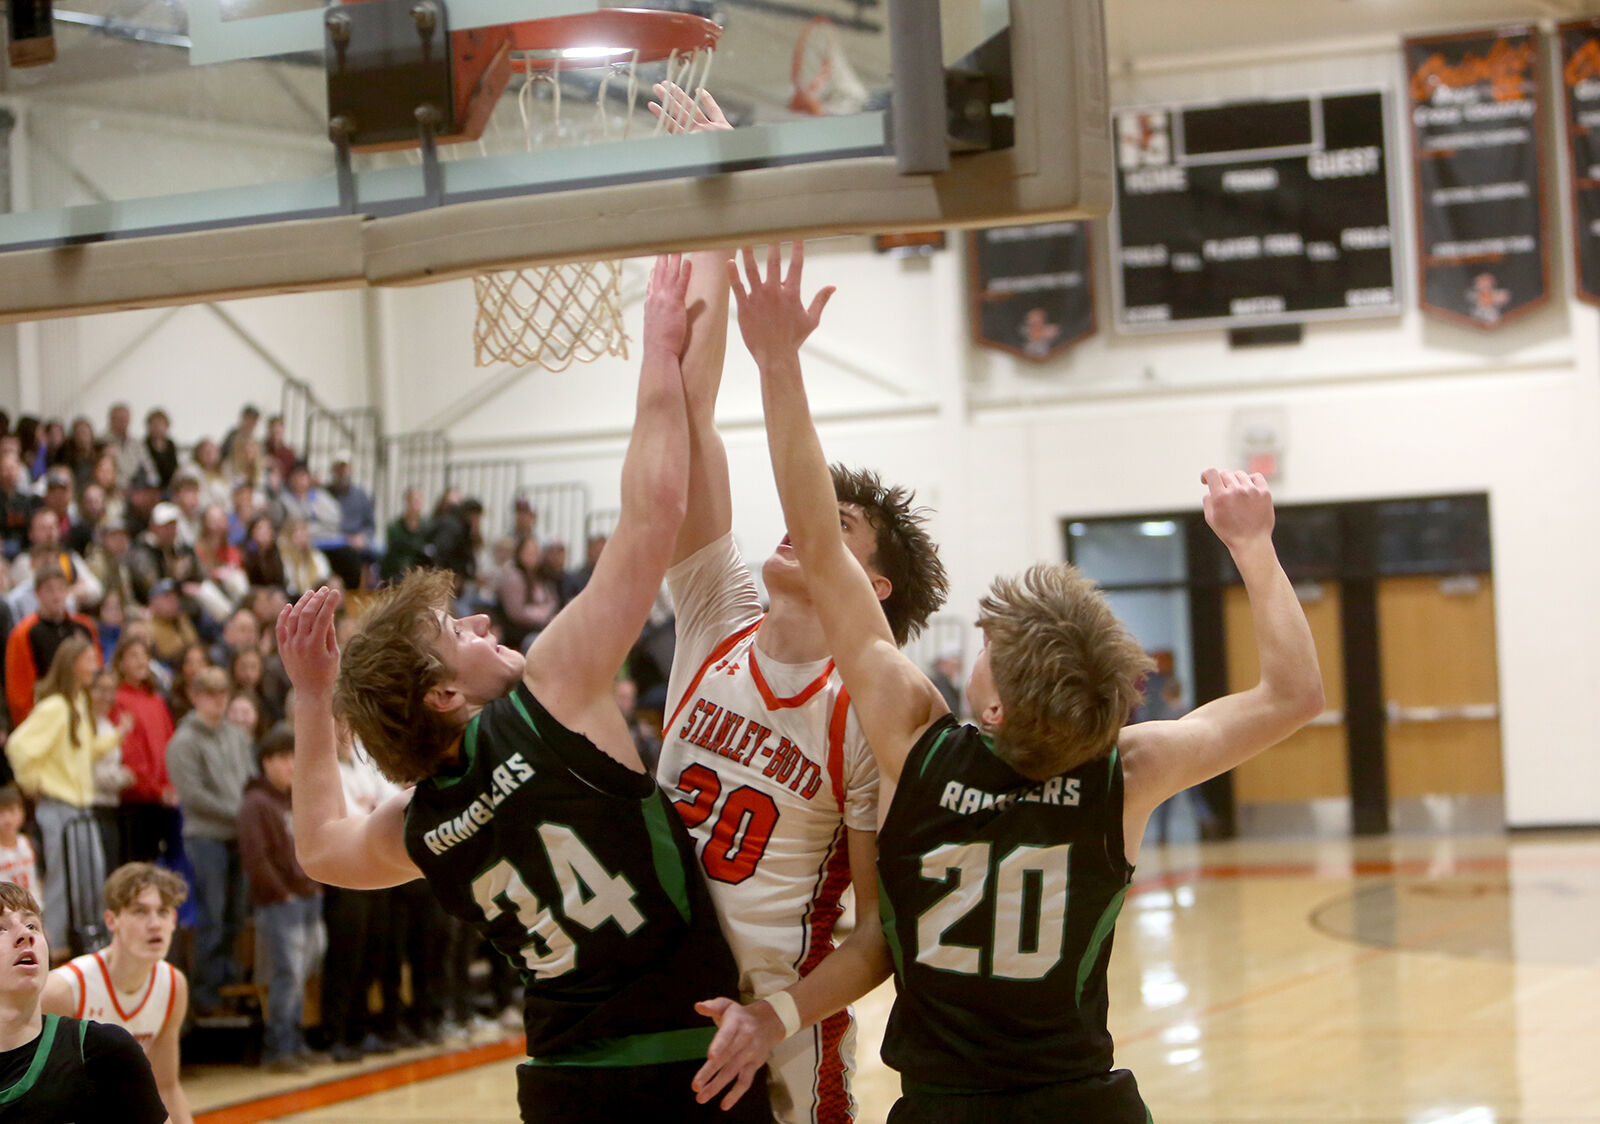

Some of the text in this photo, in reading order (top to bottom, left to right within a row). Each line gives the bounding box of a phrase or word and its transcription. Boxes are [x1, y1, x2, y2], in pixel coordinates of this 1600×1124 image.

[1307, 145, 1380, 180] GUEST
[679, 697, 824, 801] STANLEY-BOYD
[671, 761, 781, 886] 20
[470, 819, 649, 981] 34
[914, 841, 1073, 982] 20
